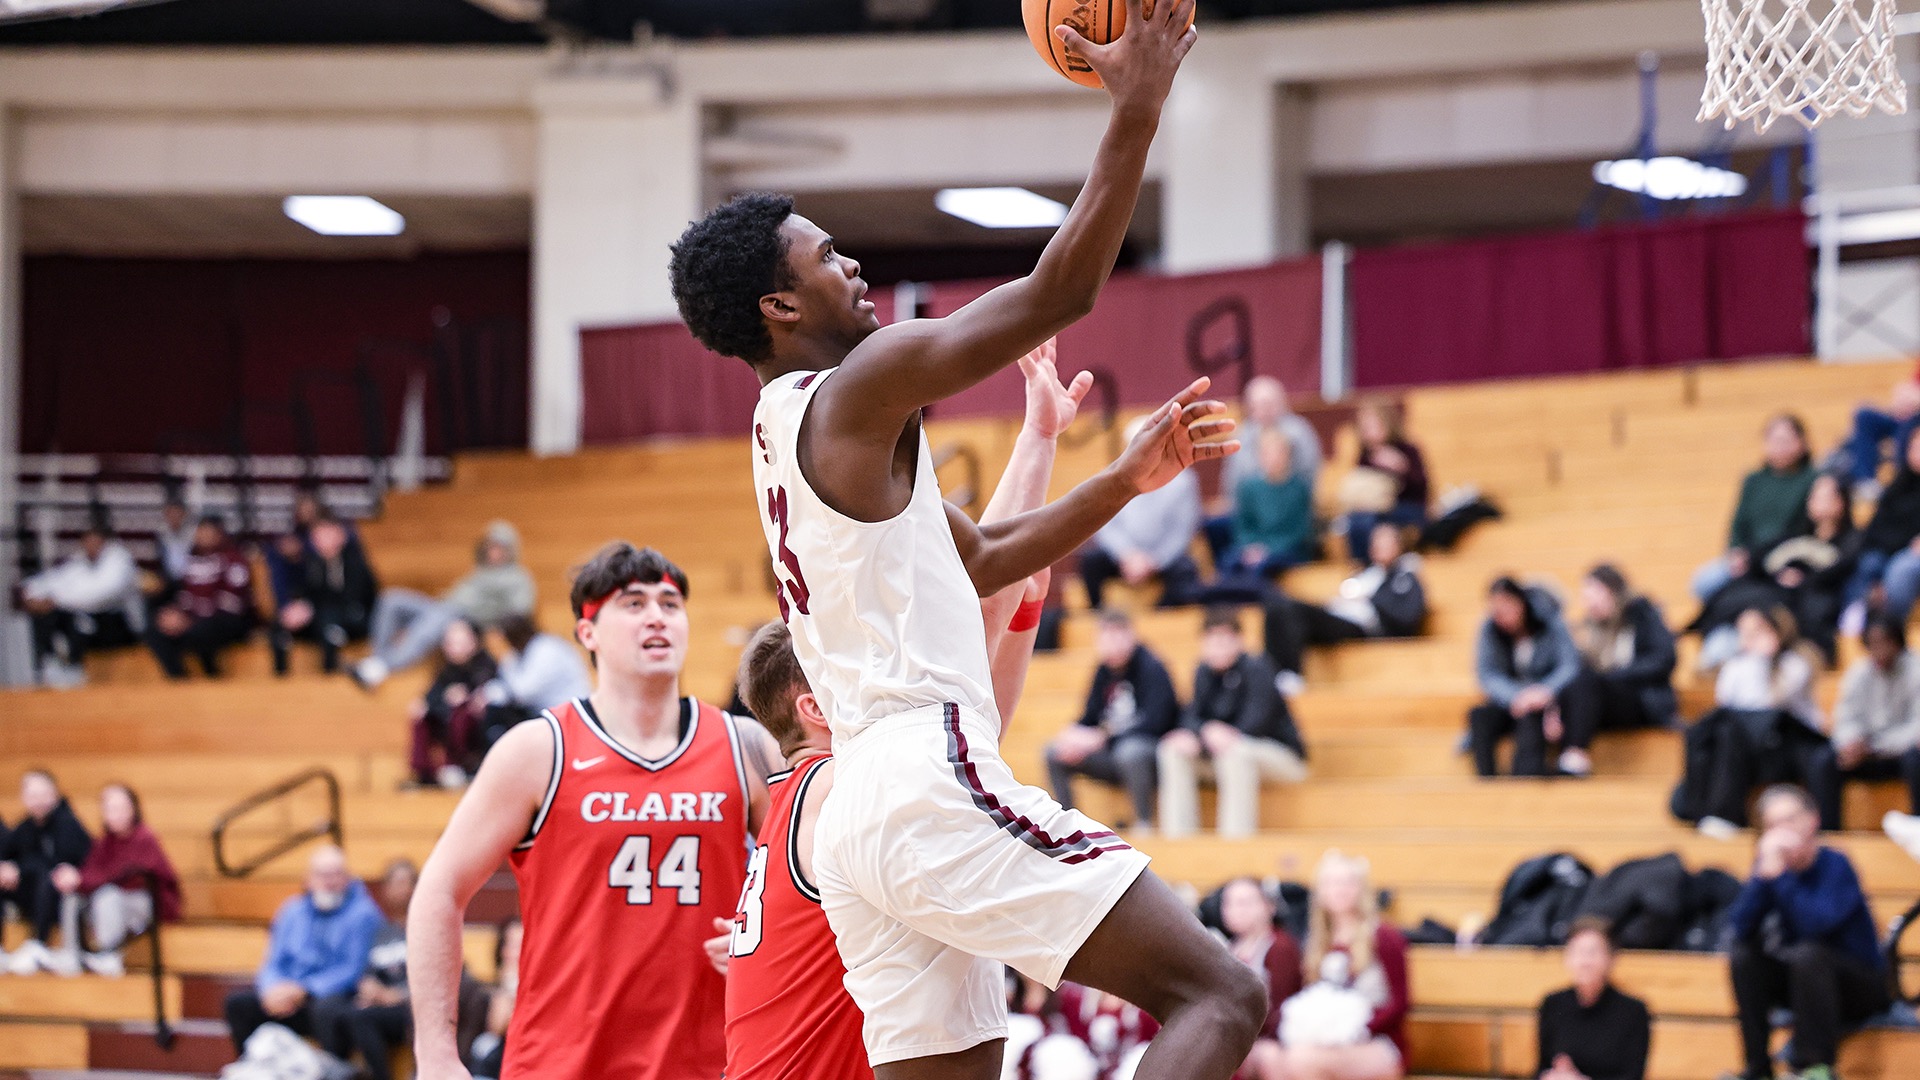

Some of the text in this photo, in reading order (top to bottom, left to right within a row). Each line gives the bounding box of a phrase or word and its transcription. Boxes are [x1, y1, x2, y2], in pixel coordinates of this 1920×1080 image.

[766, 484, 811, 625] 3
[580, 791, 727, 823] CLARK
[608, 834, 701, 905] 44
[728, 843, 769, 958] 3
